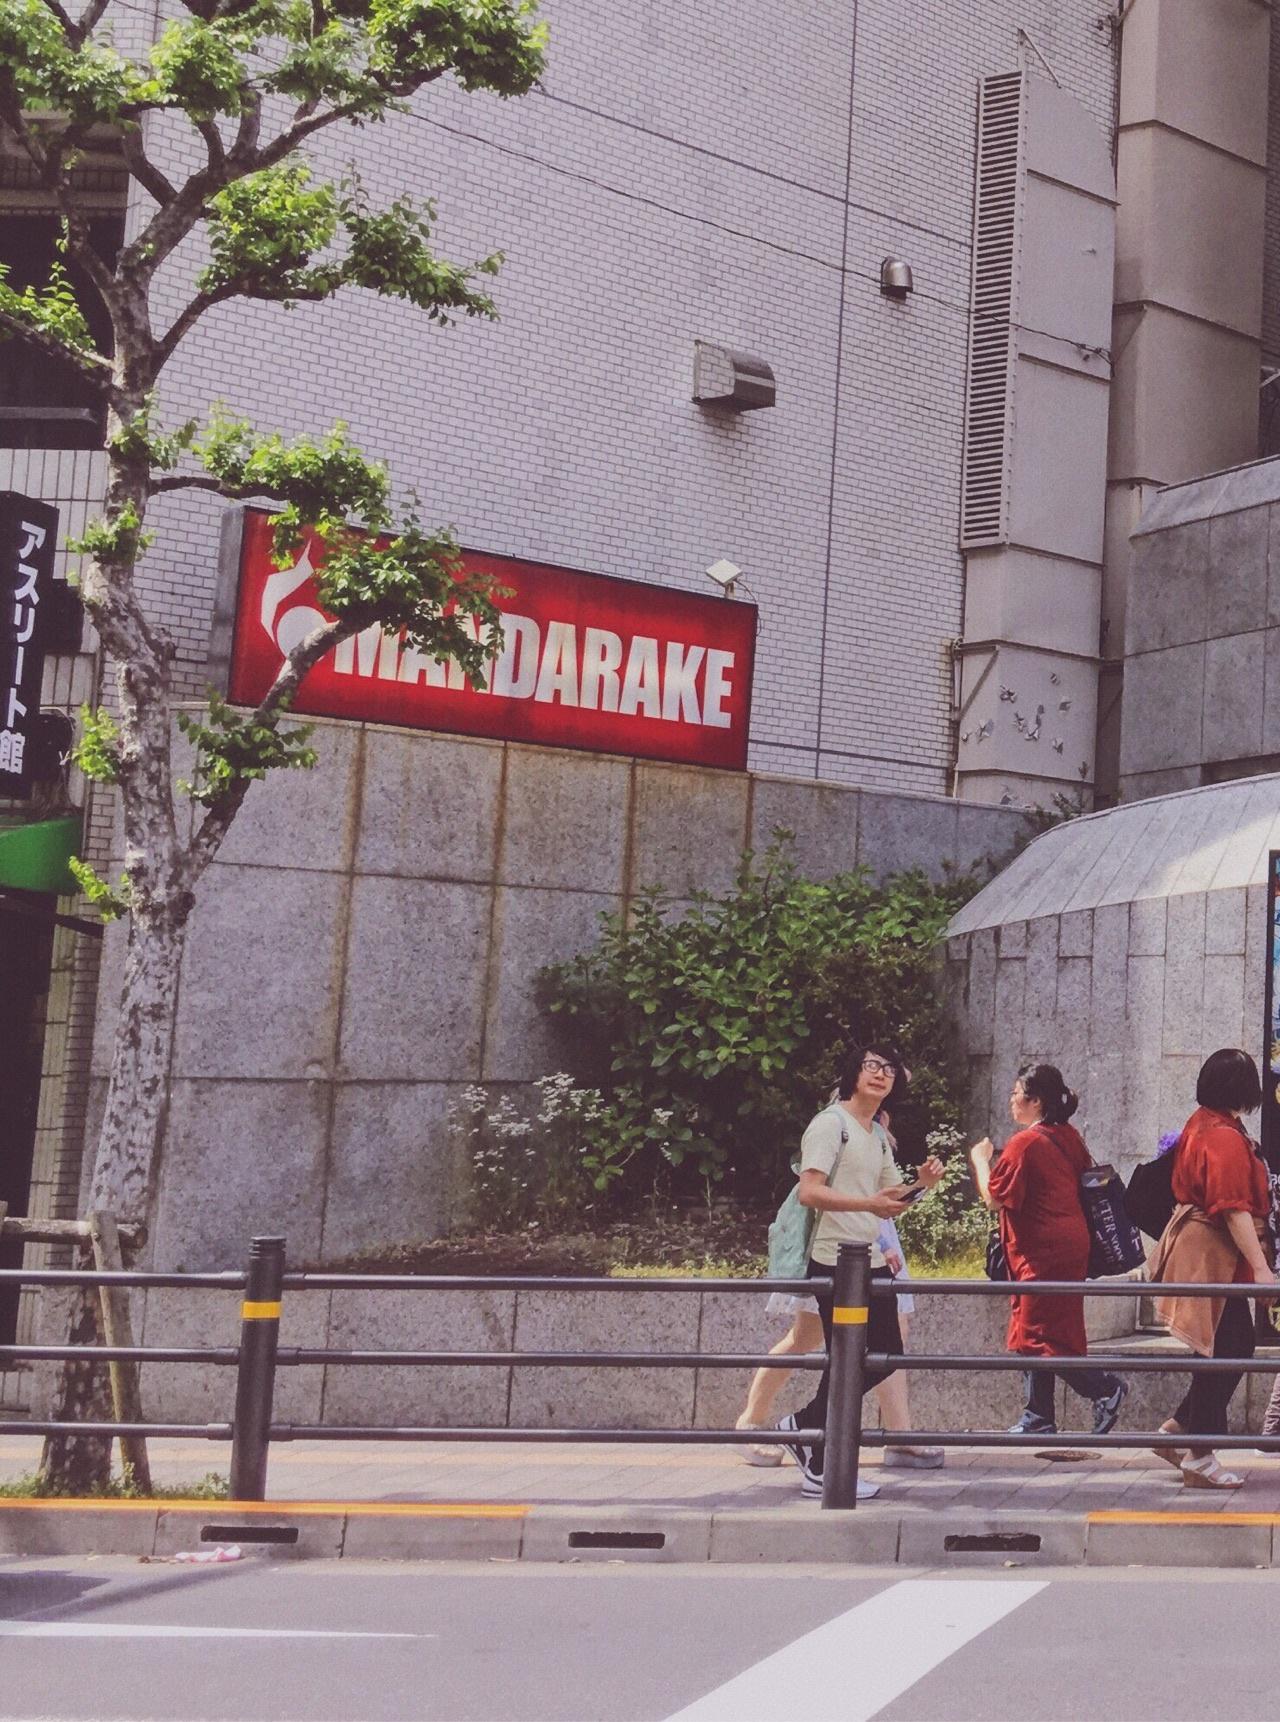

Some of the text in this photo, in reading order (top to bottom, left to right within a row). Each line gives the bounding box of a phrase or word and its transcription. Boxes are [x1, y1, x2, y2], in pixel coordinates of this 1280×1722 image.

[0, 520, 47, 775] アスリート館
